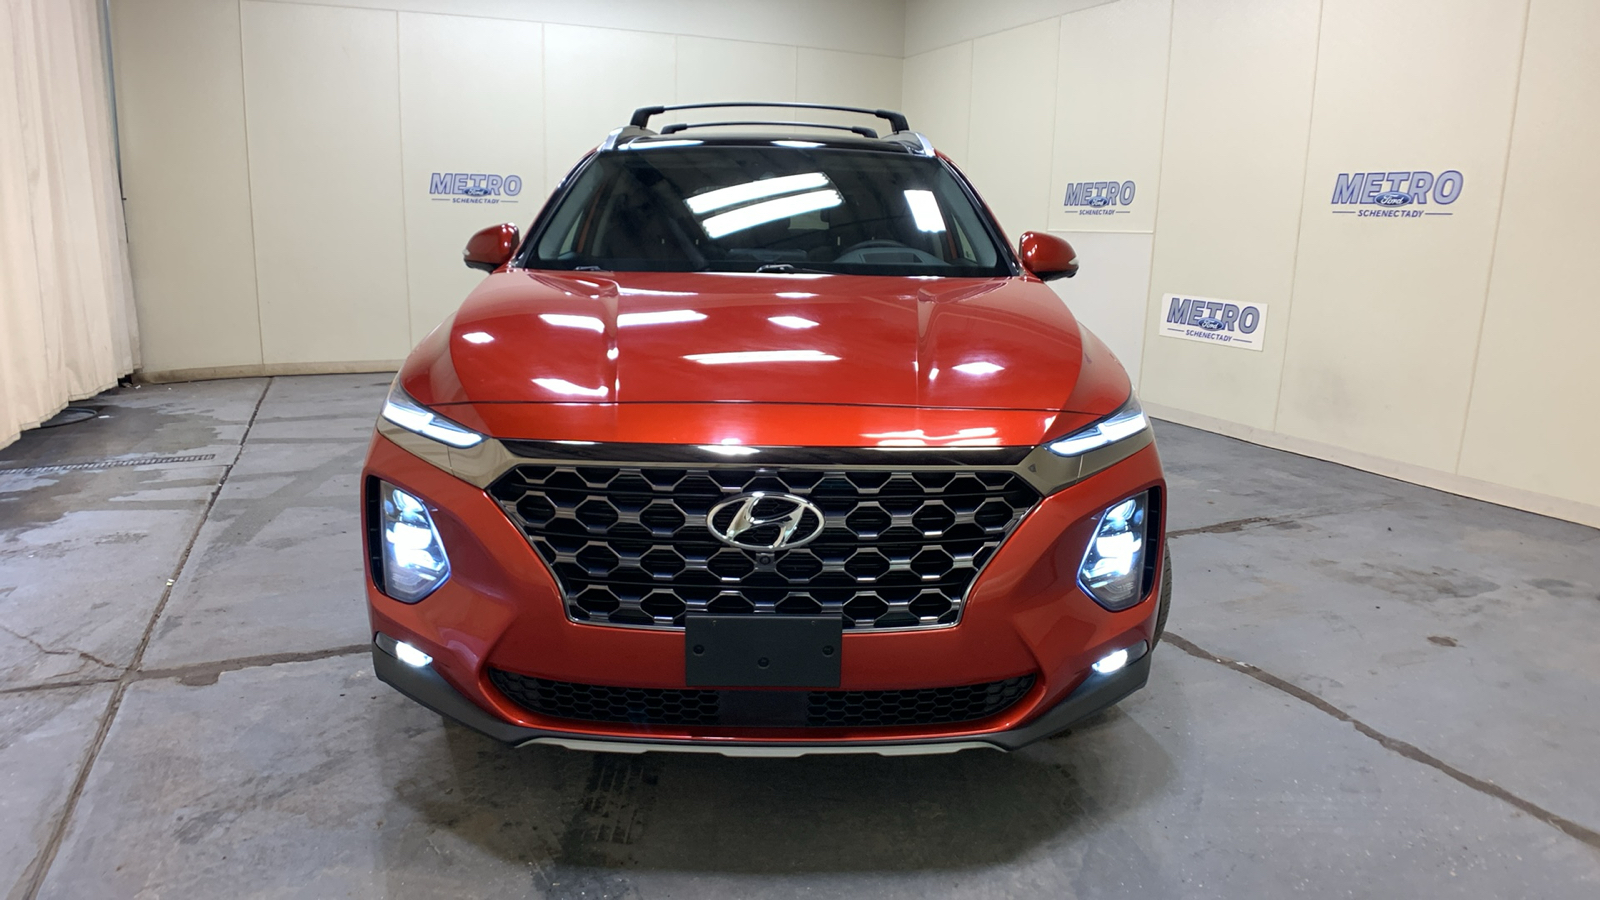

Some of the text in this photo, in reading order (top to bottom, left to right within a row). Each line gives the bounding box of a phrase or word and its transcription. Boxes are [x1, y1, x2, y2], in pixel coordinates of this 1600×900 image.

[429, 172, 522, 196] METRO
[1064, 180, 1136, 206] METRO
[1330, 170, 1464, 205] METRO
[1357, 209, 1425, 218] SCHENECTADY
[1166, 297, 1261, 335] METRO
[1185, 329, 1233, 342] SCHENECTADY
